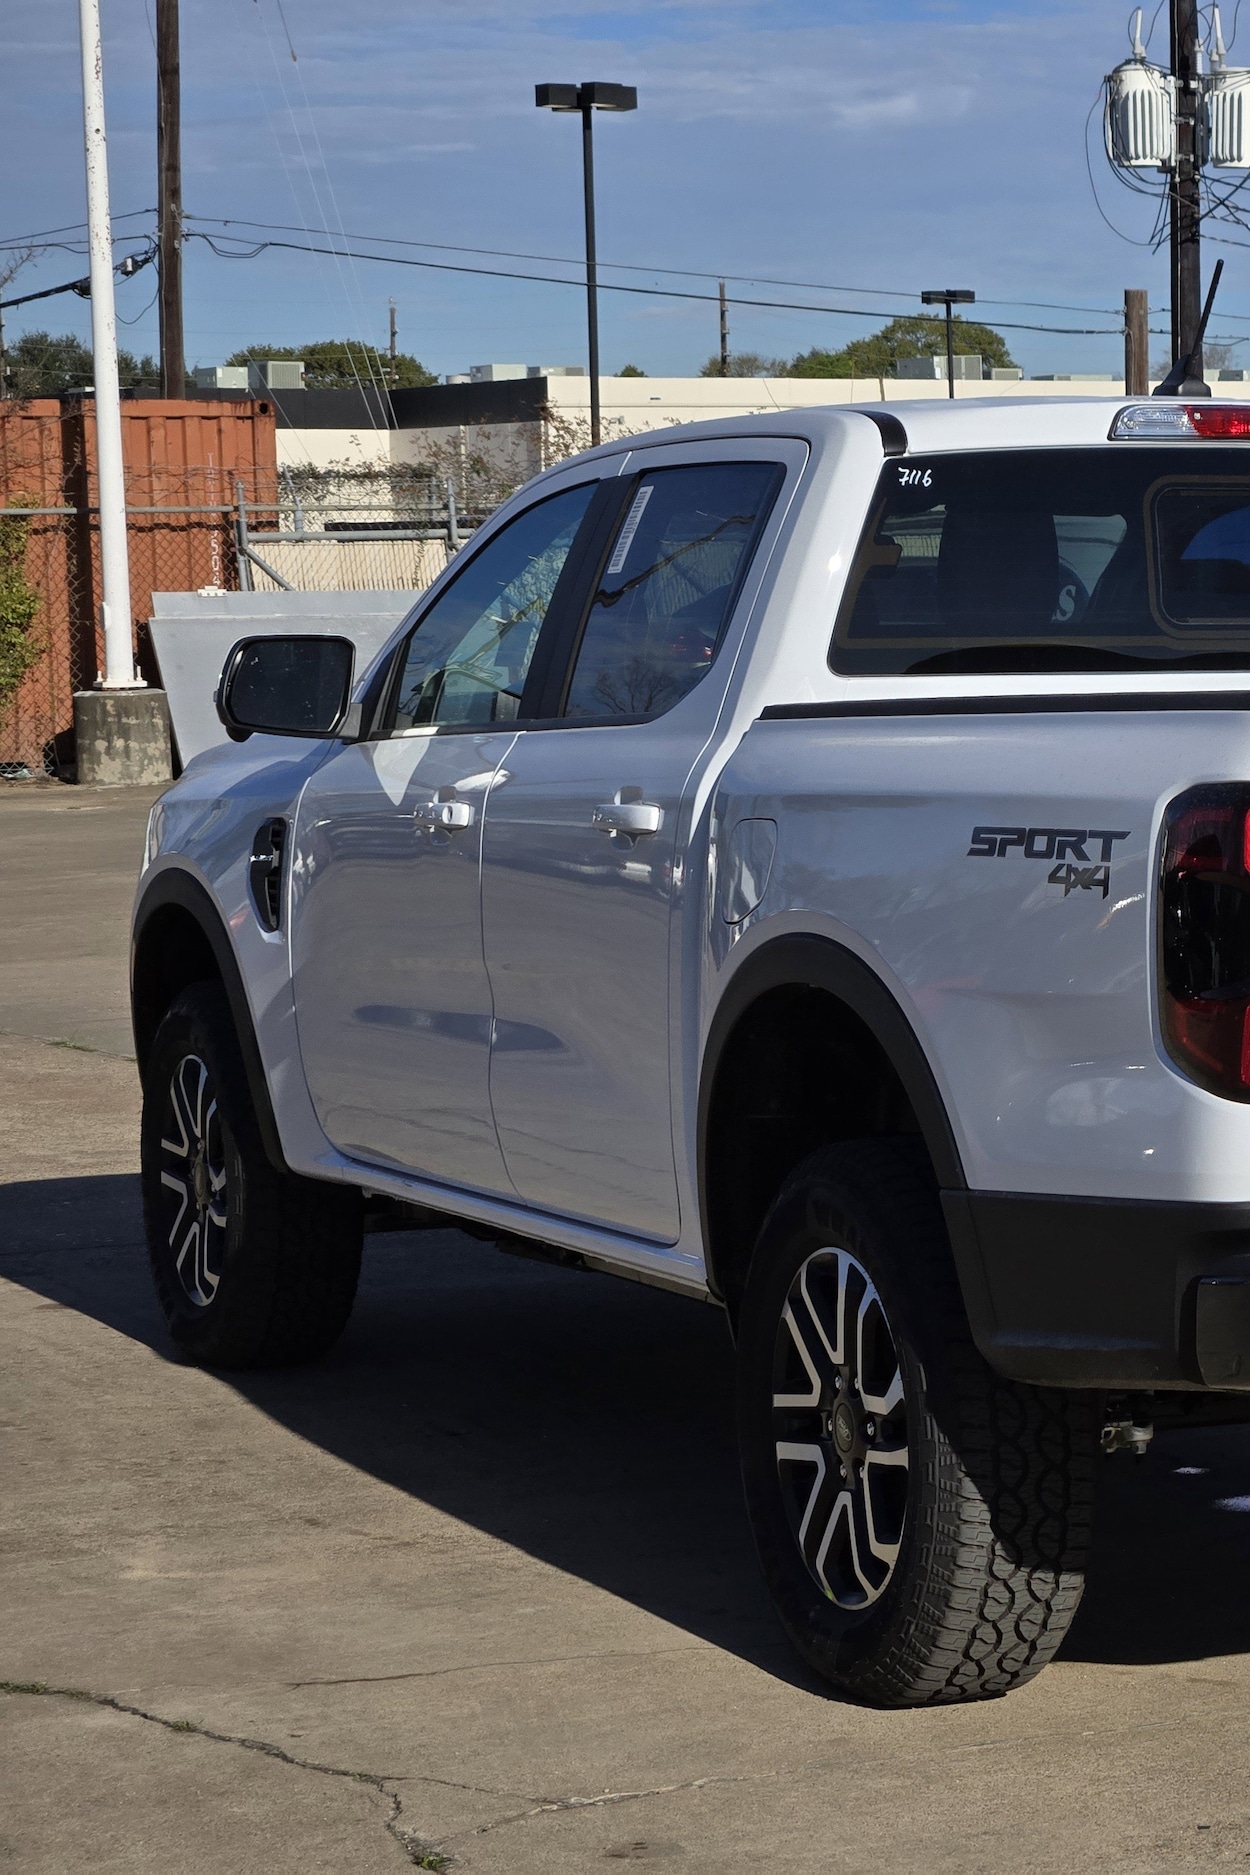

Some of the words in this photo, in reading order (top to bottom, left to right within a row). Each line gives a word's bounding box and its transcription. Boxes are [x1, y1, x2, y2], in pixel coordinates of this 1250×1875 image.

[898, 467, 933, 487] 7116
[967, 826, 1131, 862] SPORT
[1048, 863, 1110, 899] 4x4
